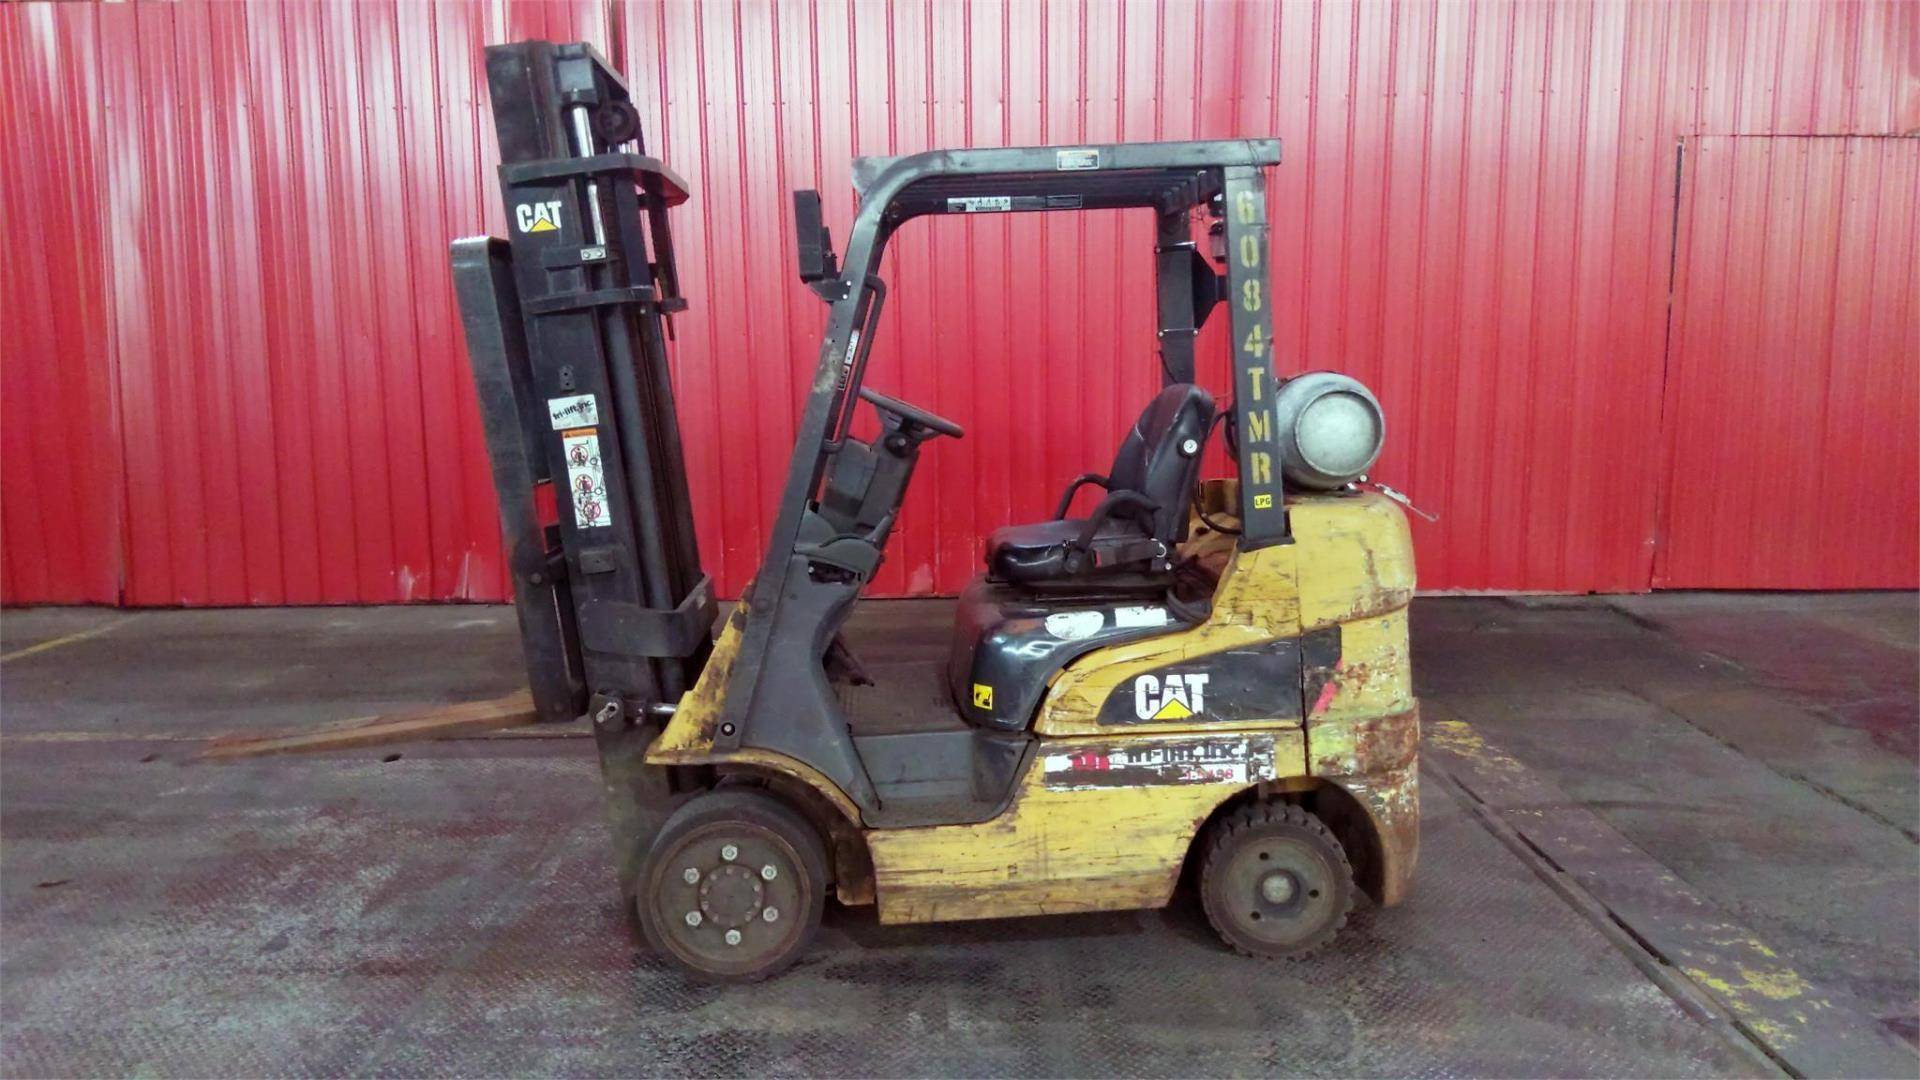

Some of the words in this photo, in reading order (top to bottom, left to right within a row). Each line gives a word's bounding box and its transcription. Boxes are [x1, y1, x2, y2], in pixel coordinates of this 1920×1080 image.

[516, 201, 562, 233] CAT
[1255, 497, 1271, 507] LPG
[1135, 674, 1209, 720] CAT
